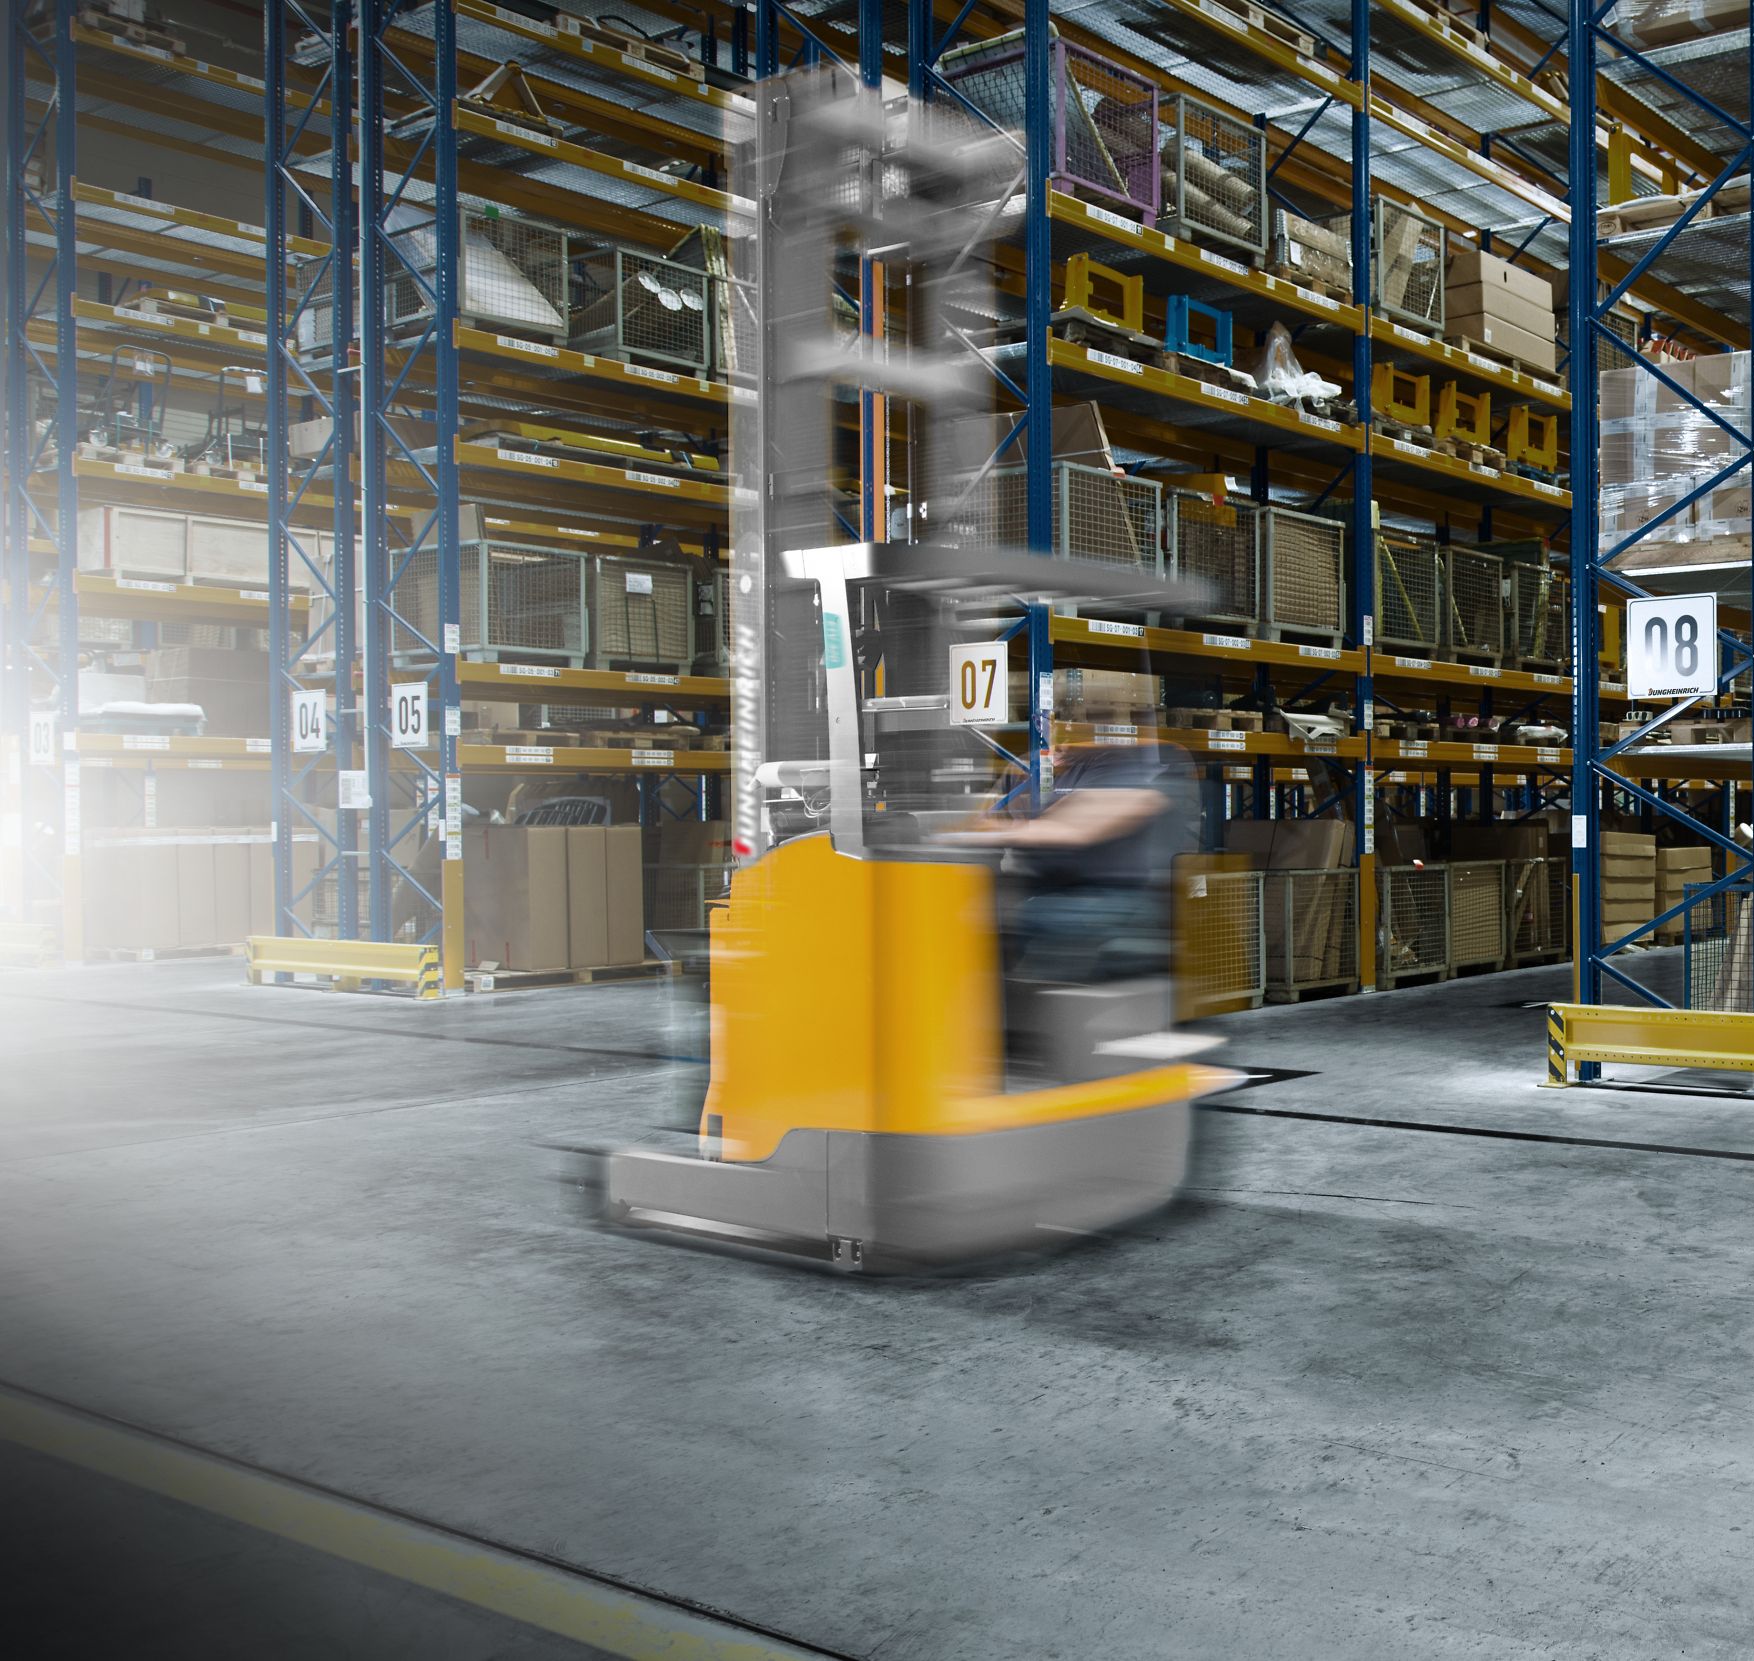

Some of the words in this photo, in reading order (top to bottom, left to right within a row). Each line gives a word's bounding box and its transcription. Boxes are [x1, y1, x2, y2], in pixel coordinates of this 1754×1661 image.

[1644, 614, 1698, 677] 08
[961, 659, 997, 710] 07
[1648, 687, 1699, 696] JUNGHEINRICH
[299, 702, 321, 740] 04
[398, 695, 421, 735] 05
[34, 721, 50, 755] 03
